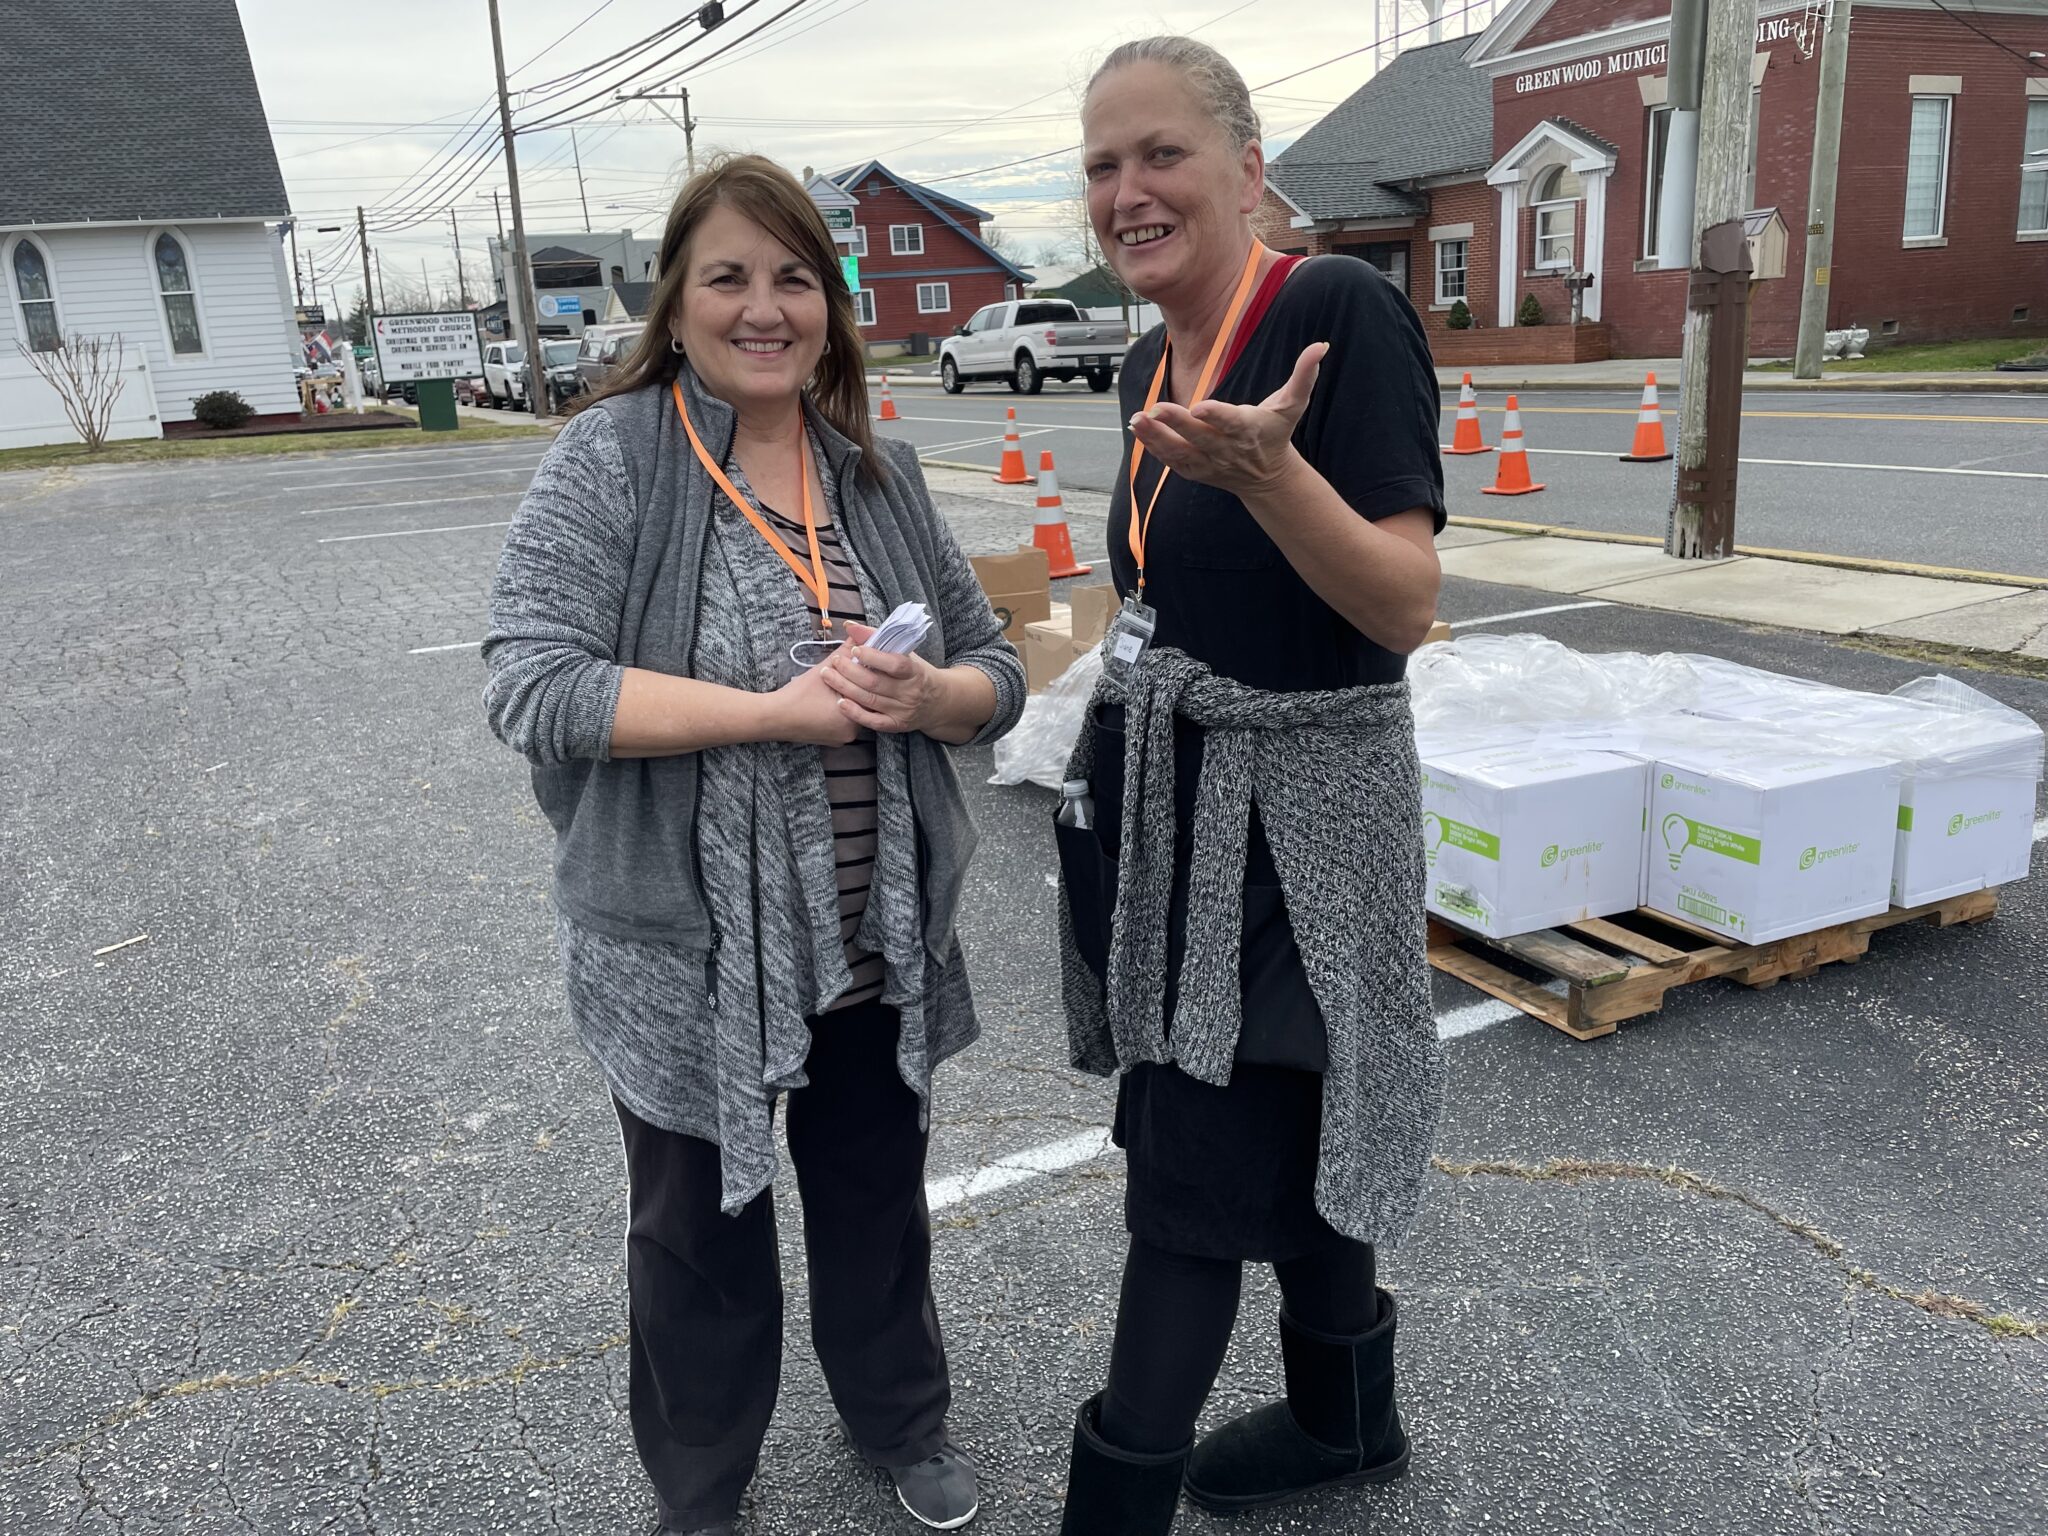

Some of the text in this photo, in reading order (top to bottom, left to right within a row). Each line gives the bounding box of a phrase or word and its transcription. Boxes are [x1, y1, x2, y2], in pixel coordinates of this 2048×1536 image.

[1515, 59, 1602, 94] GREENWOOD
[1607, 43, 1669, 74] MUNICI
[389, 317, 439, 326] GREENWOOD
[391, 324, 472, 334] METHODIST CHURCH
[386, 337, 417, 345] CHRISTMAS
[433, 335, 455, 343] SERVICE
[391, 345, 422, 353] CHRISTMAS
[1964, 809, 2001, 829] greenlite
[1561, 841, 1602, 861] greenlite
[1818, 843, 1858, 863] greenlite
[1682, 885, 1696, 897] SKU
